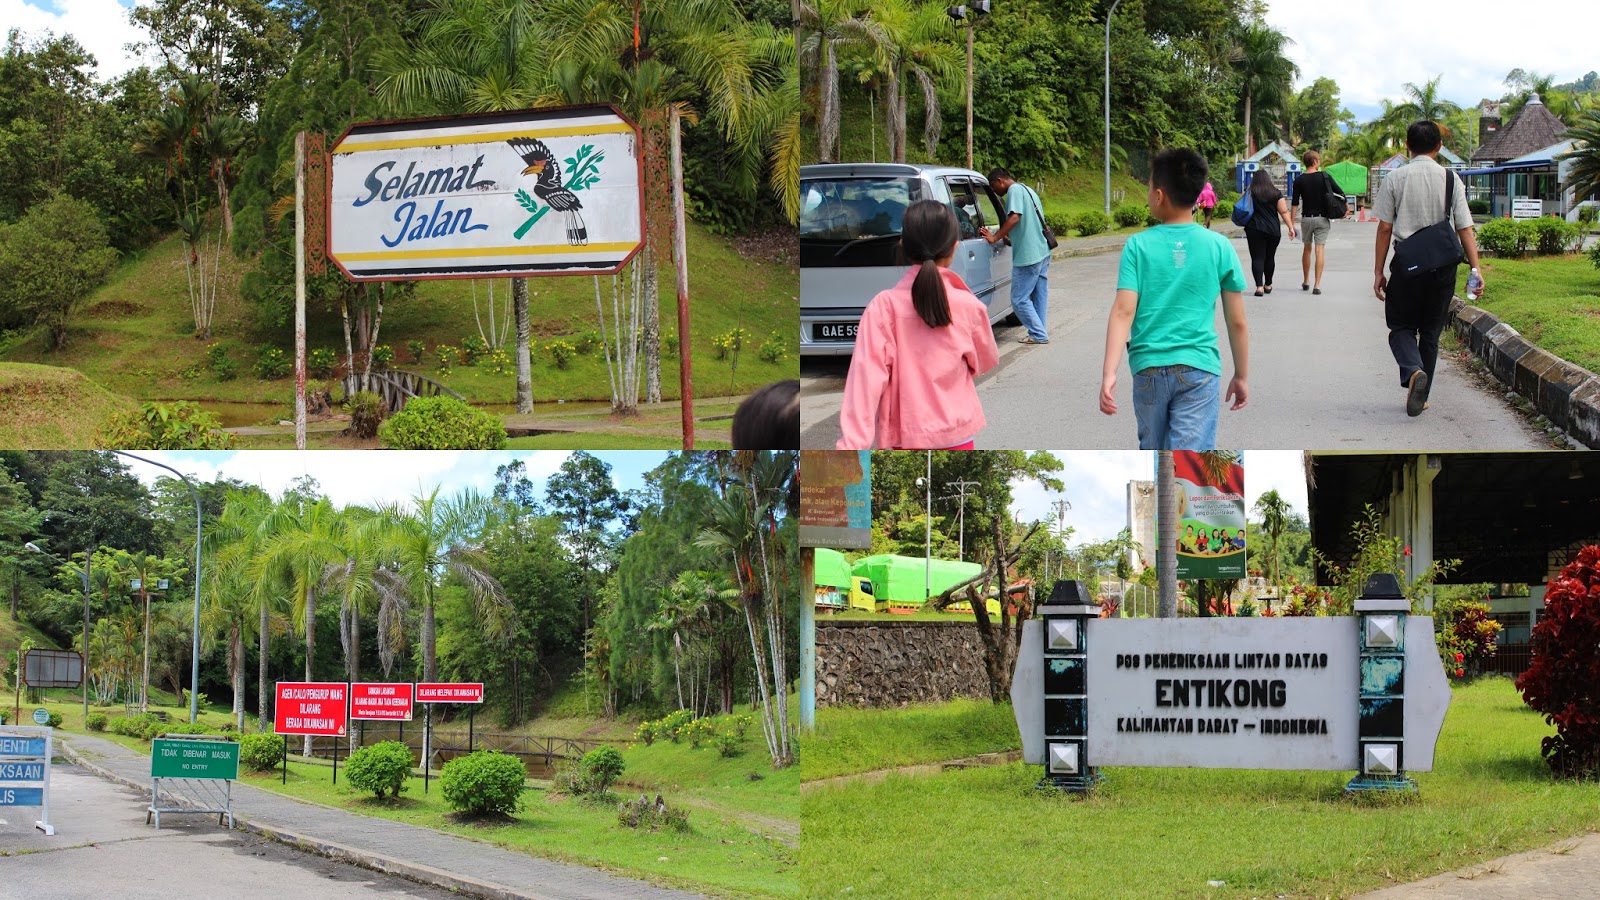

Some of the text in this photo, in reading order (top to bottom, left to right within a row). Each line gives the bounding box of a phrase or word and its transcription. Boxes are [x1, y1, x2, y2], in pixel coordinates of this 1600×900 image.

[352, 154, 496, 207] Selamat
[380, 199, 489, 248] Jalan
[822, 325, 845, 337] QAE
[1116, 653, 1328, 669] POS PEMERIKSAAN LINTAS BATAS
[1156, 679, 1287, 708] ENTIKONG
[299, 703, 321, 714] DILARANG
[285, 717, 302, 729] BERADA
[1117, 717, 1193, 733] KALIMANTAN
[1197, 718, 1238, 734] BARAT
[1260, 718, 1328, 735] INDONESIA
[161, 749, 231, 759] TIDAK DIBENAR MASUK
